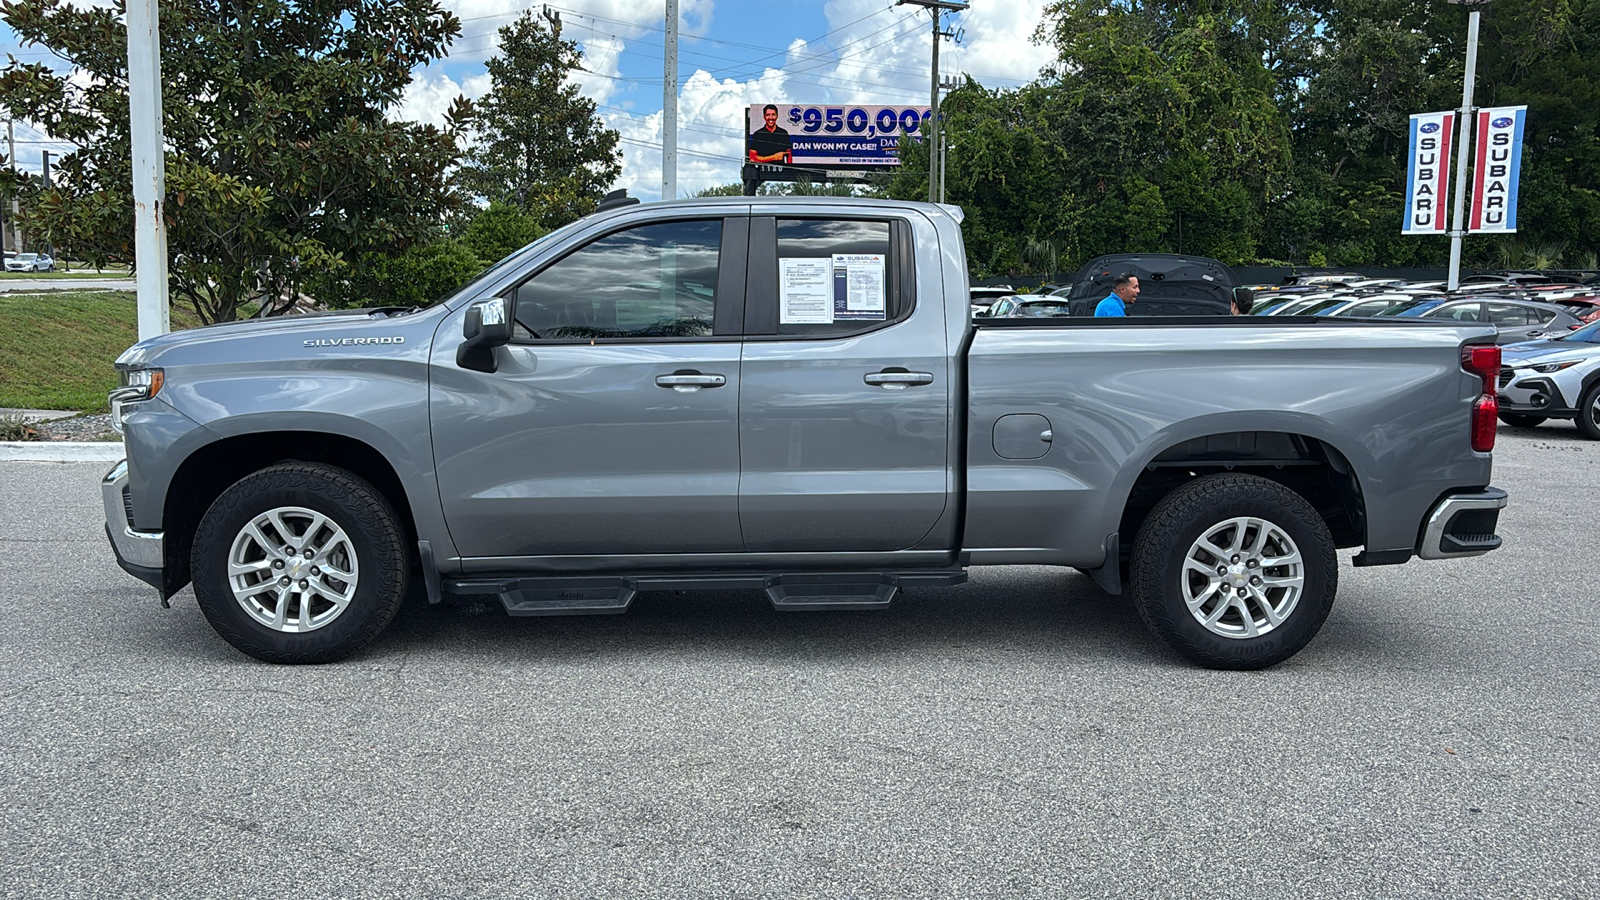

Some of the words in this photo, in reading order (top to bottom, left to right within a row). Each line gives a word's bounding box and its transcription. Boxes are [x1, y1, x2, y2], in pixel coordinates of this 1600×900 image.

[792, 142, 812, 150] DAN
[812, 142, 835, 151] WON
[835, 142, 849, 151] MY
[849, 143, 878, 151] CASE!!
[1415, 138, 1436, 225] SUBARU
[1485, 133, 1509, 223] SUBARU
[303, 336, 405, 347] SILVERADO
